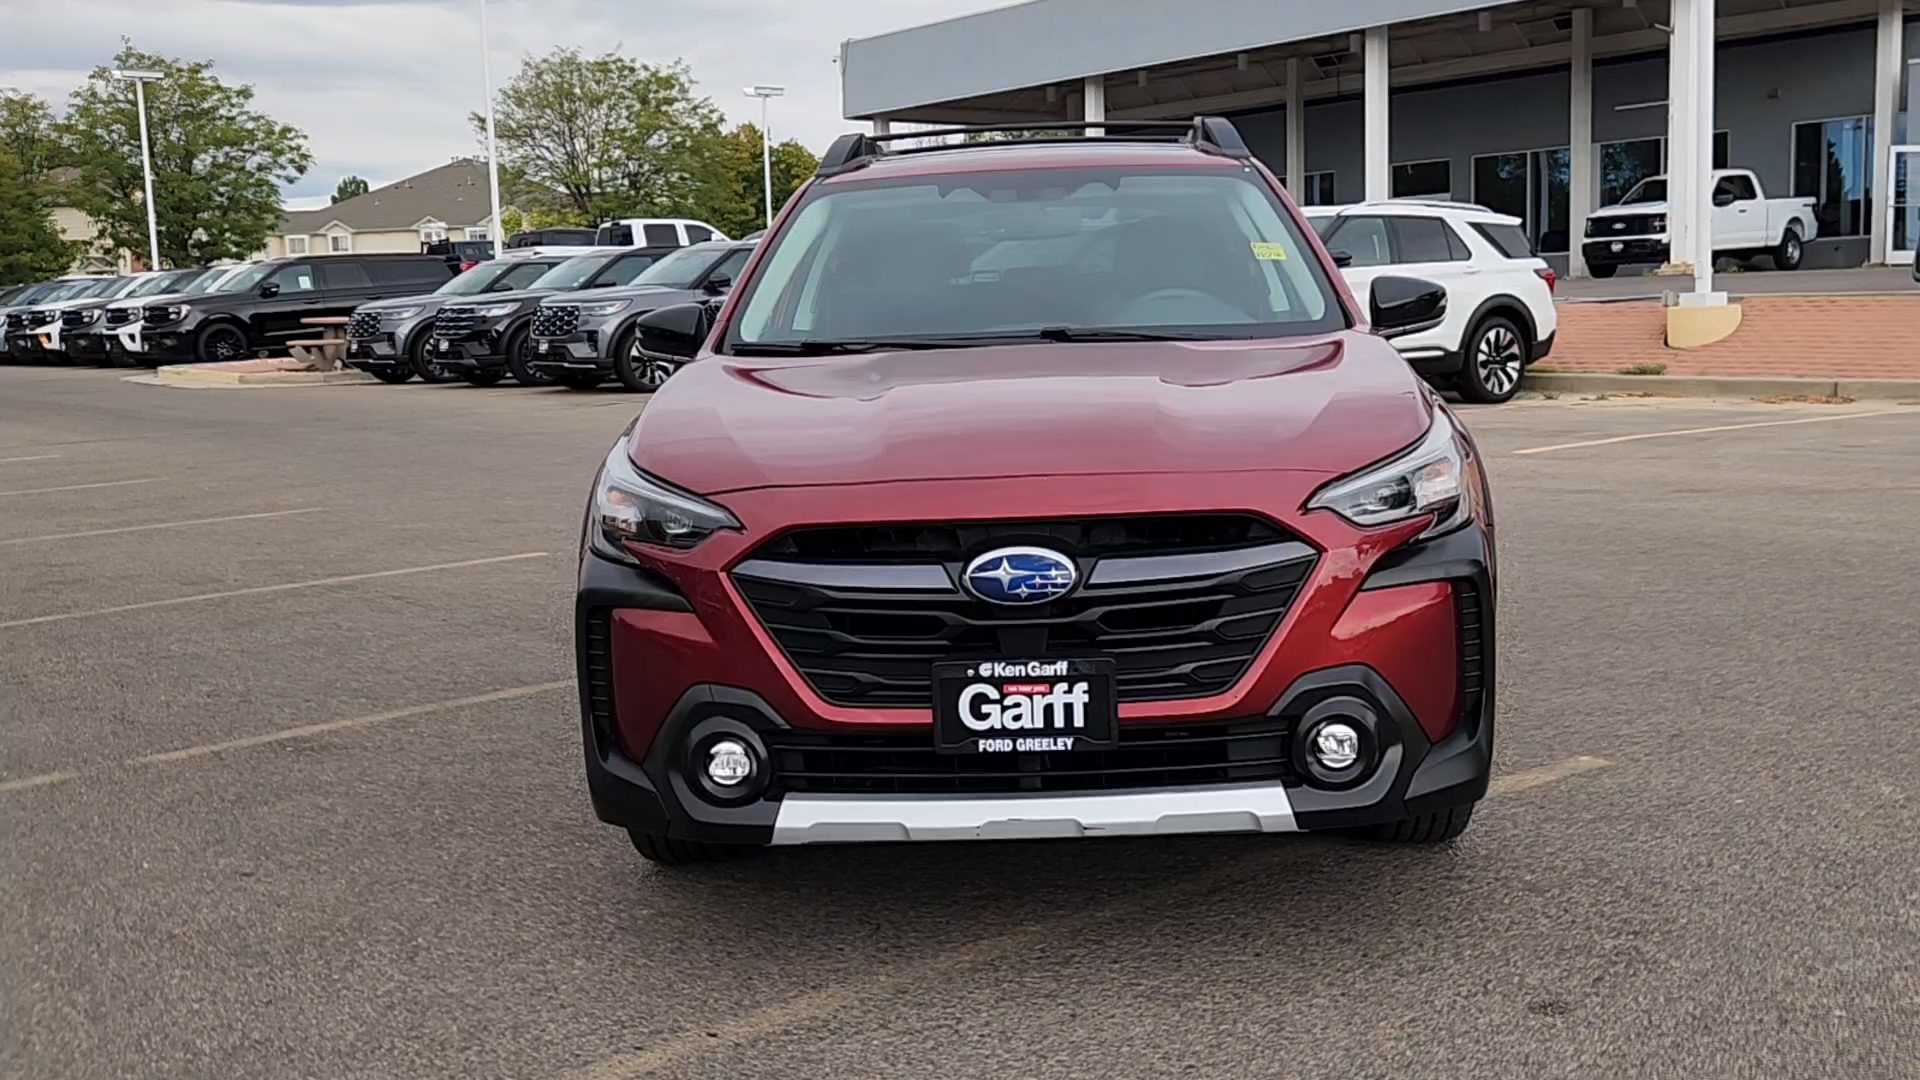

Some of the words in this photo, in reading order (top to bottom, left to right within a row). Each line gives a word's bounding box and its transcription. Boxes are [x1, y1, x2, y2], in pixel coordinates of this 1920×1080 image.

[994, 662, 1026, 677] Ken
[1027, 661, 1068, 676] Garff
[958, 682, 1089, 731] Garff
[978, 739, 1013, 752] FORD
[1016, 737, 1074, 751] GREELEY
